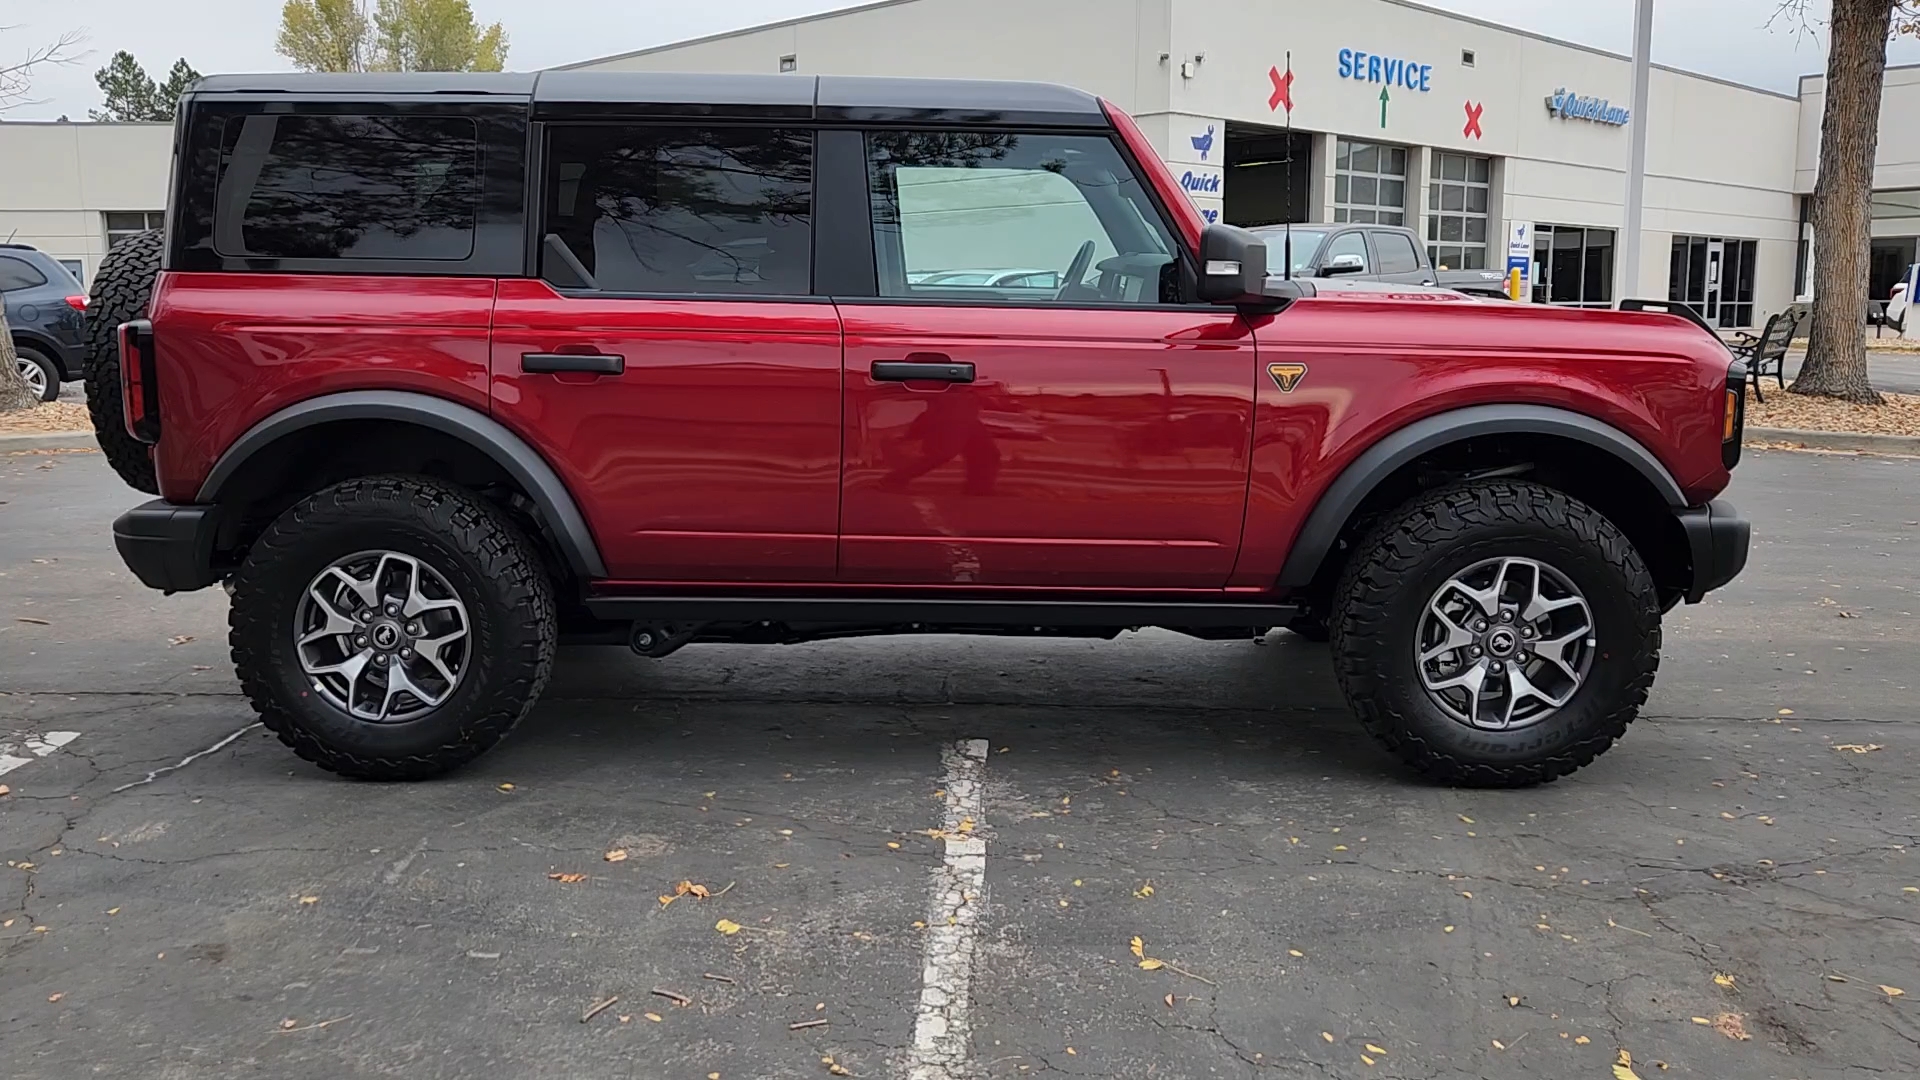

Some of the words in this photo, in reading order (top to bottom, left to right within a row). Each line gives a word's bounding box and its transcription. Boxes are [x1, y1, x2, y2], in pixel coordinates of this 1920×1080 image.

[1338, 48, 1432, 92] SERVICE
[1565, 91, 1599, 119] Quick
[1600, 99, 1630, 125] Lane
[1181, 171, 1220, 192] Quick
